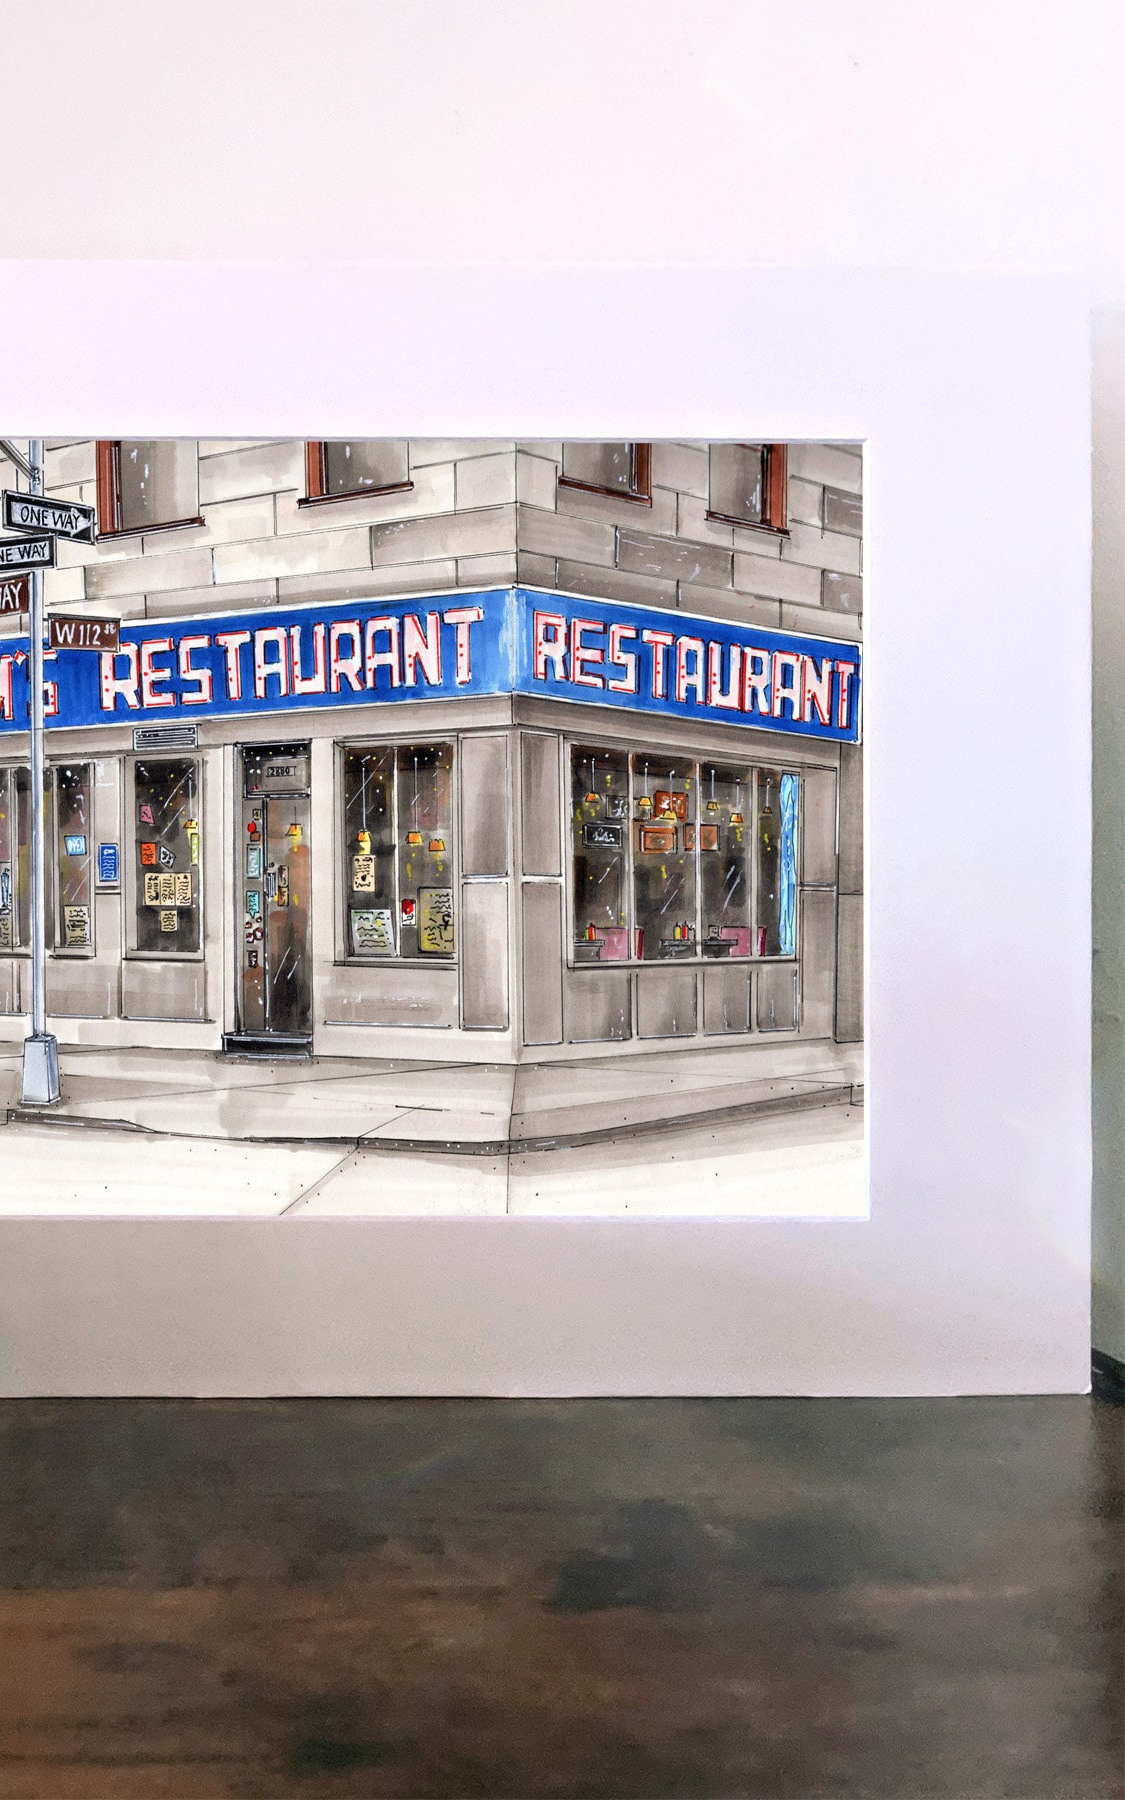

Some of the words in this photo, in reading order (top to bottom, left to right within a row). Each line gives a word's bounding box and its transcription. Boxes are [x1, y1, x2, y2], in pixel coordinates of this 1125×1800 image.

[20, 505, 49, 526] ONE
[51, 510, 81, 530] WAY
[17, 542, 48, 561] WAY
[55, 622, 75, 645] W
[79, 623, 101, 646] 112
[99, 606, 483, 712] RESTAURANT
[533, 608, 859, 730] RESTAURANT
